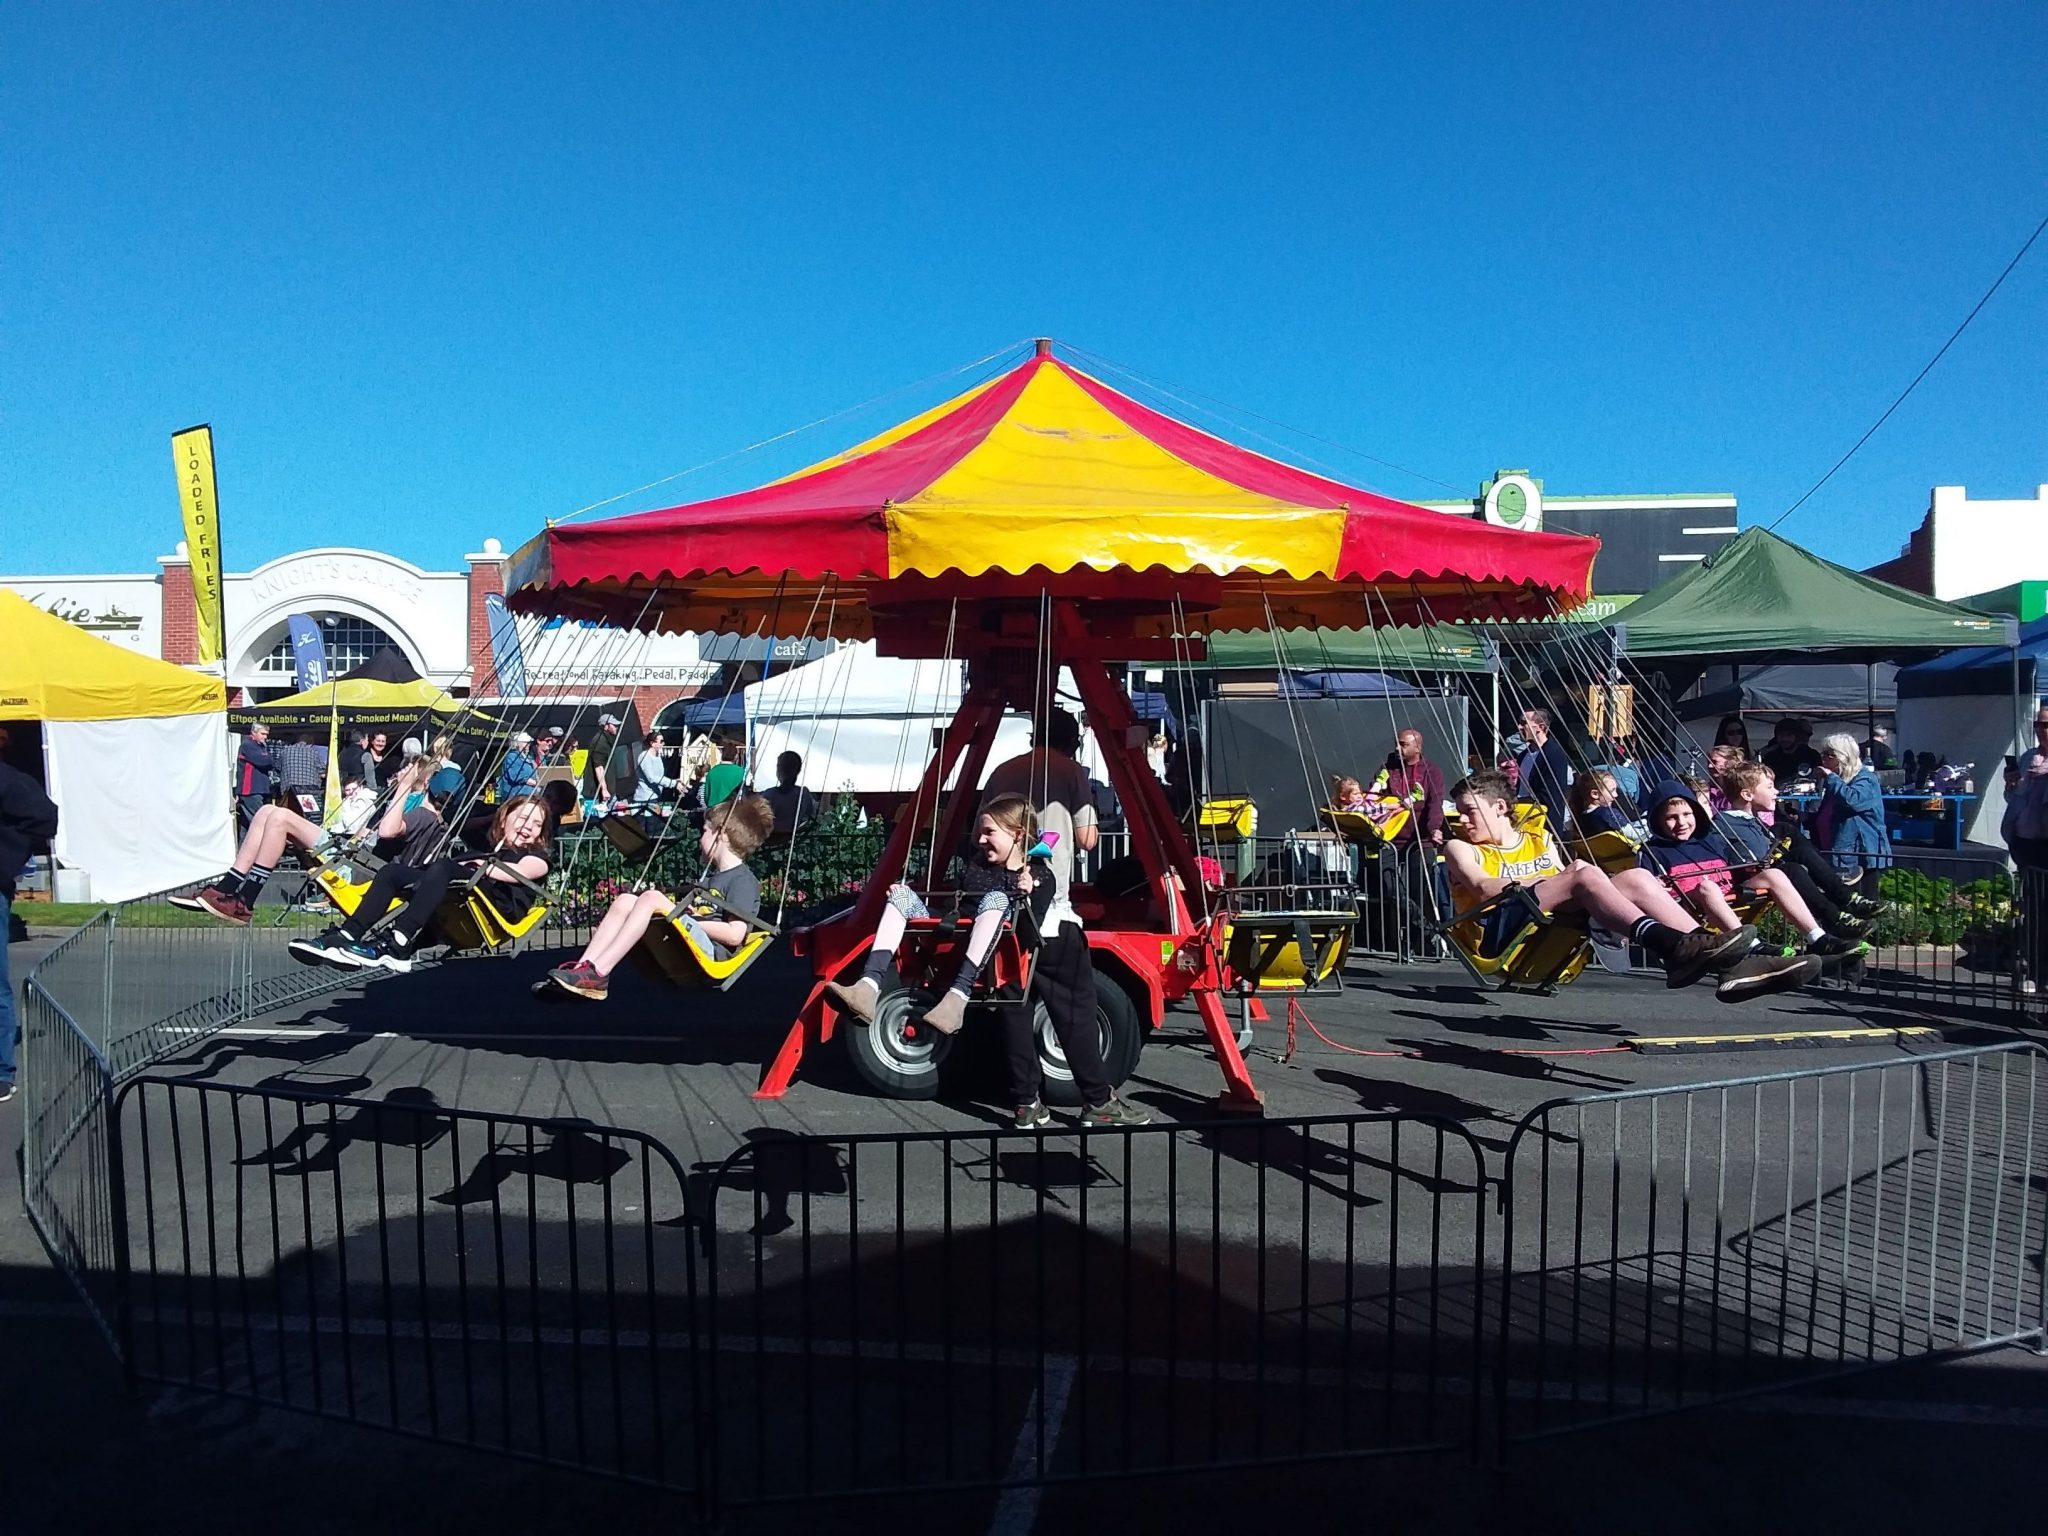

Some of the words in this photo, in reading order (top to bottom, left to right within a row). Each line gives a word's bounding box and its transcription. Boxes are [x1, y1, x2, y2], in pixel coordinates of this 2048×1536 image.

[188, 446, 206, 526] LOADED
[199, 533, 217, 600] FRIES
[524, 668, 589, 681] Recreational
[230, 714, 257, 724] Eftpos
[259, 714, 298, 724] Available
[309, 714, 345, 725] Caterng
[355, 713, 390, 723] Smoked
[391, 712, 418, 722] Meats
[1500, 853, 1553, 878] LAKERS
